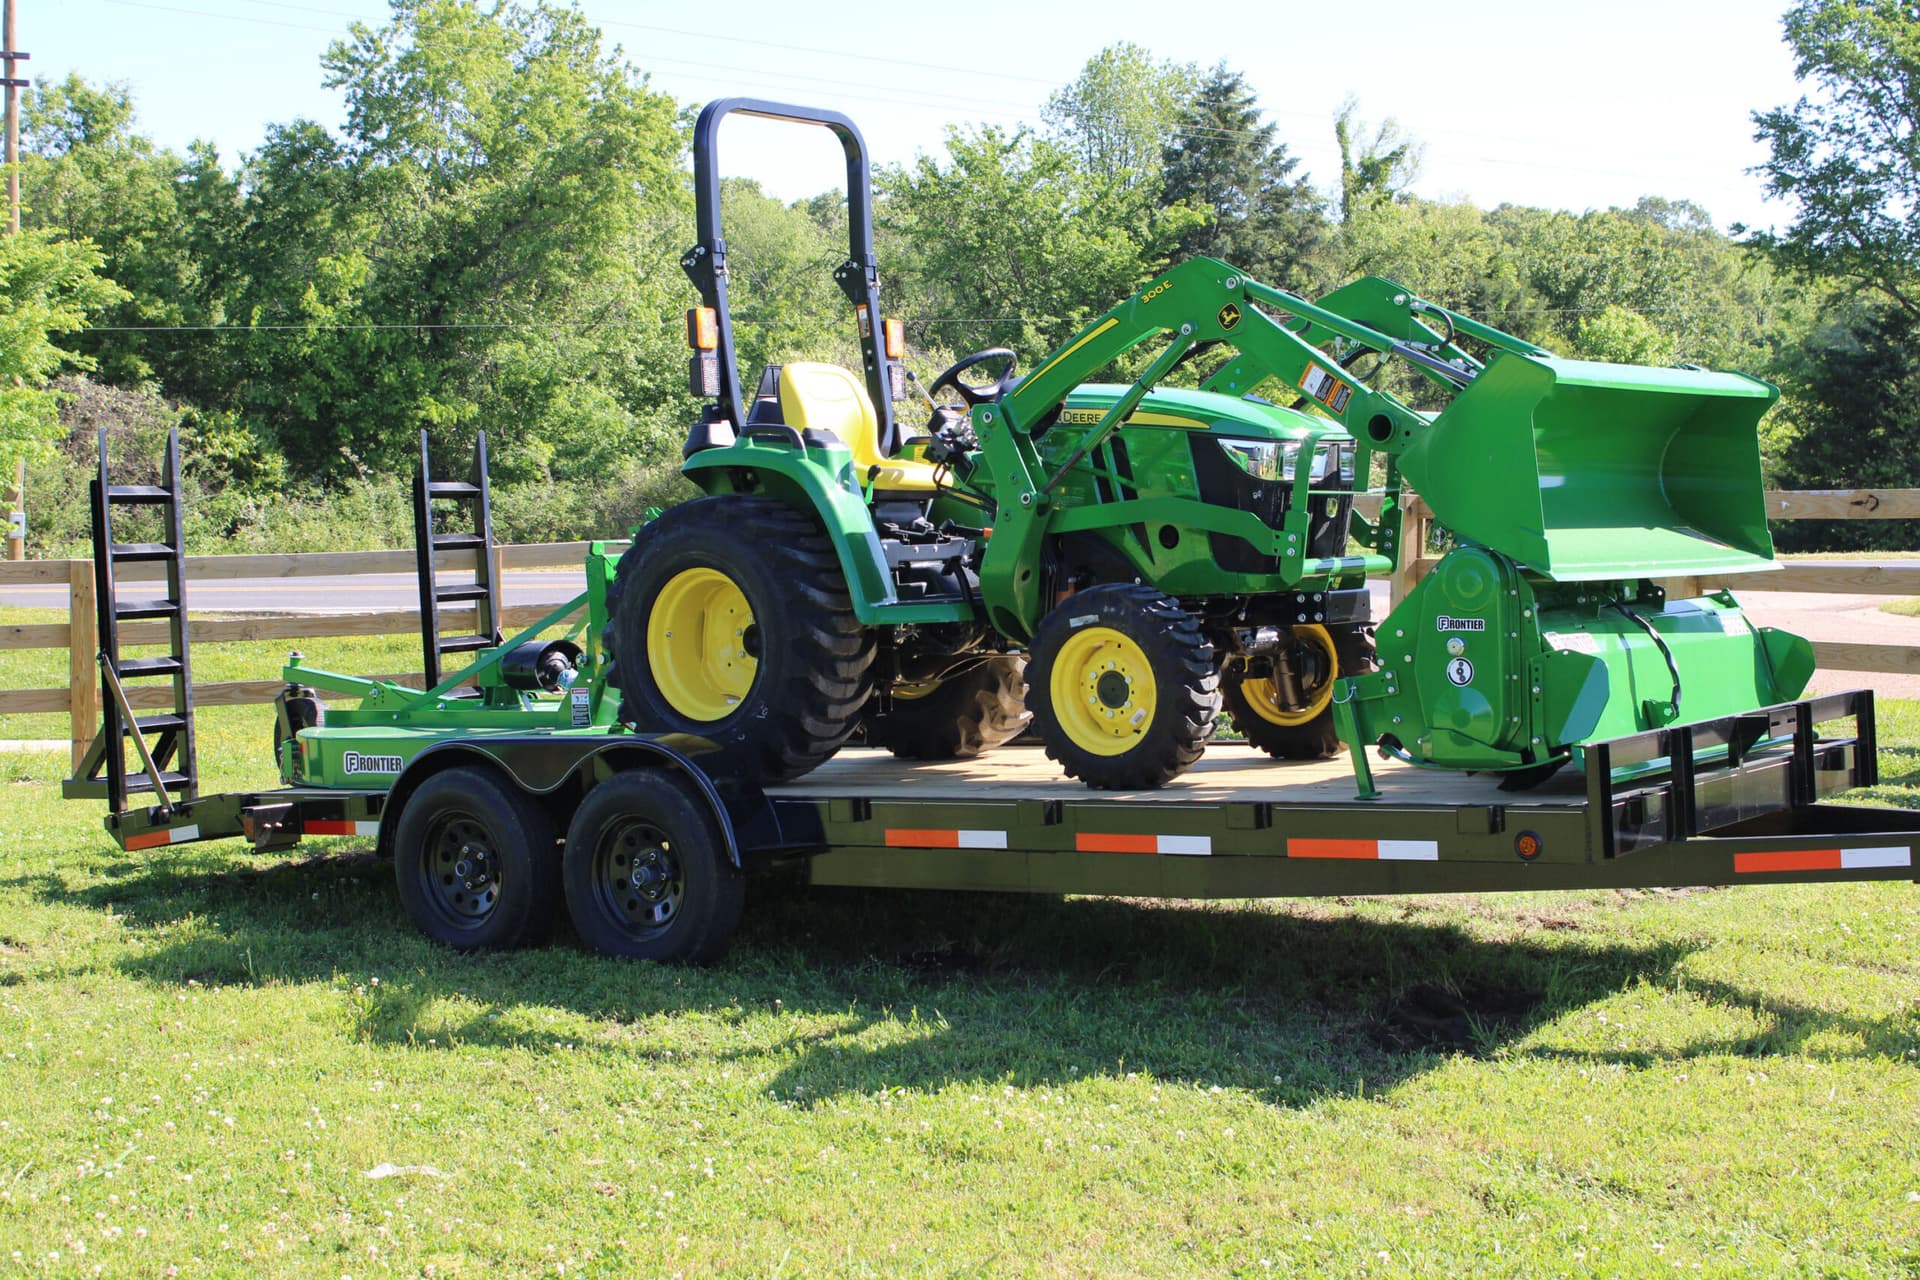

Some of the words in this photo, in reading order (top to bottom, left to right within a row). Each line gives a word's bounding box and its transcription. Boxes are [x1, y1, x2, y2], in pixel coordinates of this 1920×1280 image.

[1063, 411, 1101, 422] DEERE
[1438, 616, 1484, 630] FRONTIER
[345, 752, 402, 773] FRONTIER
